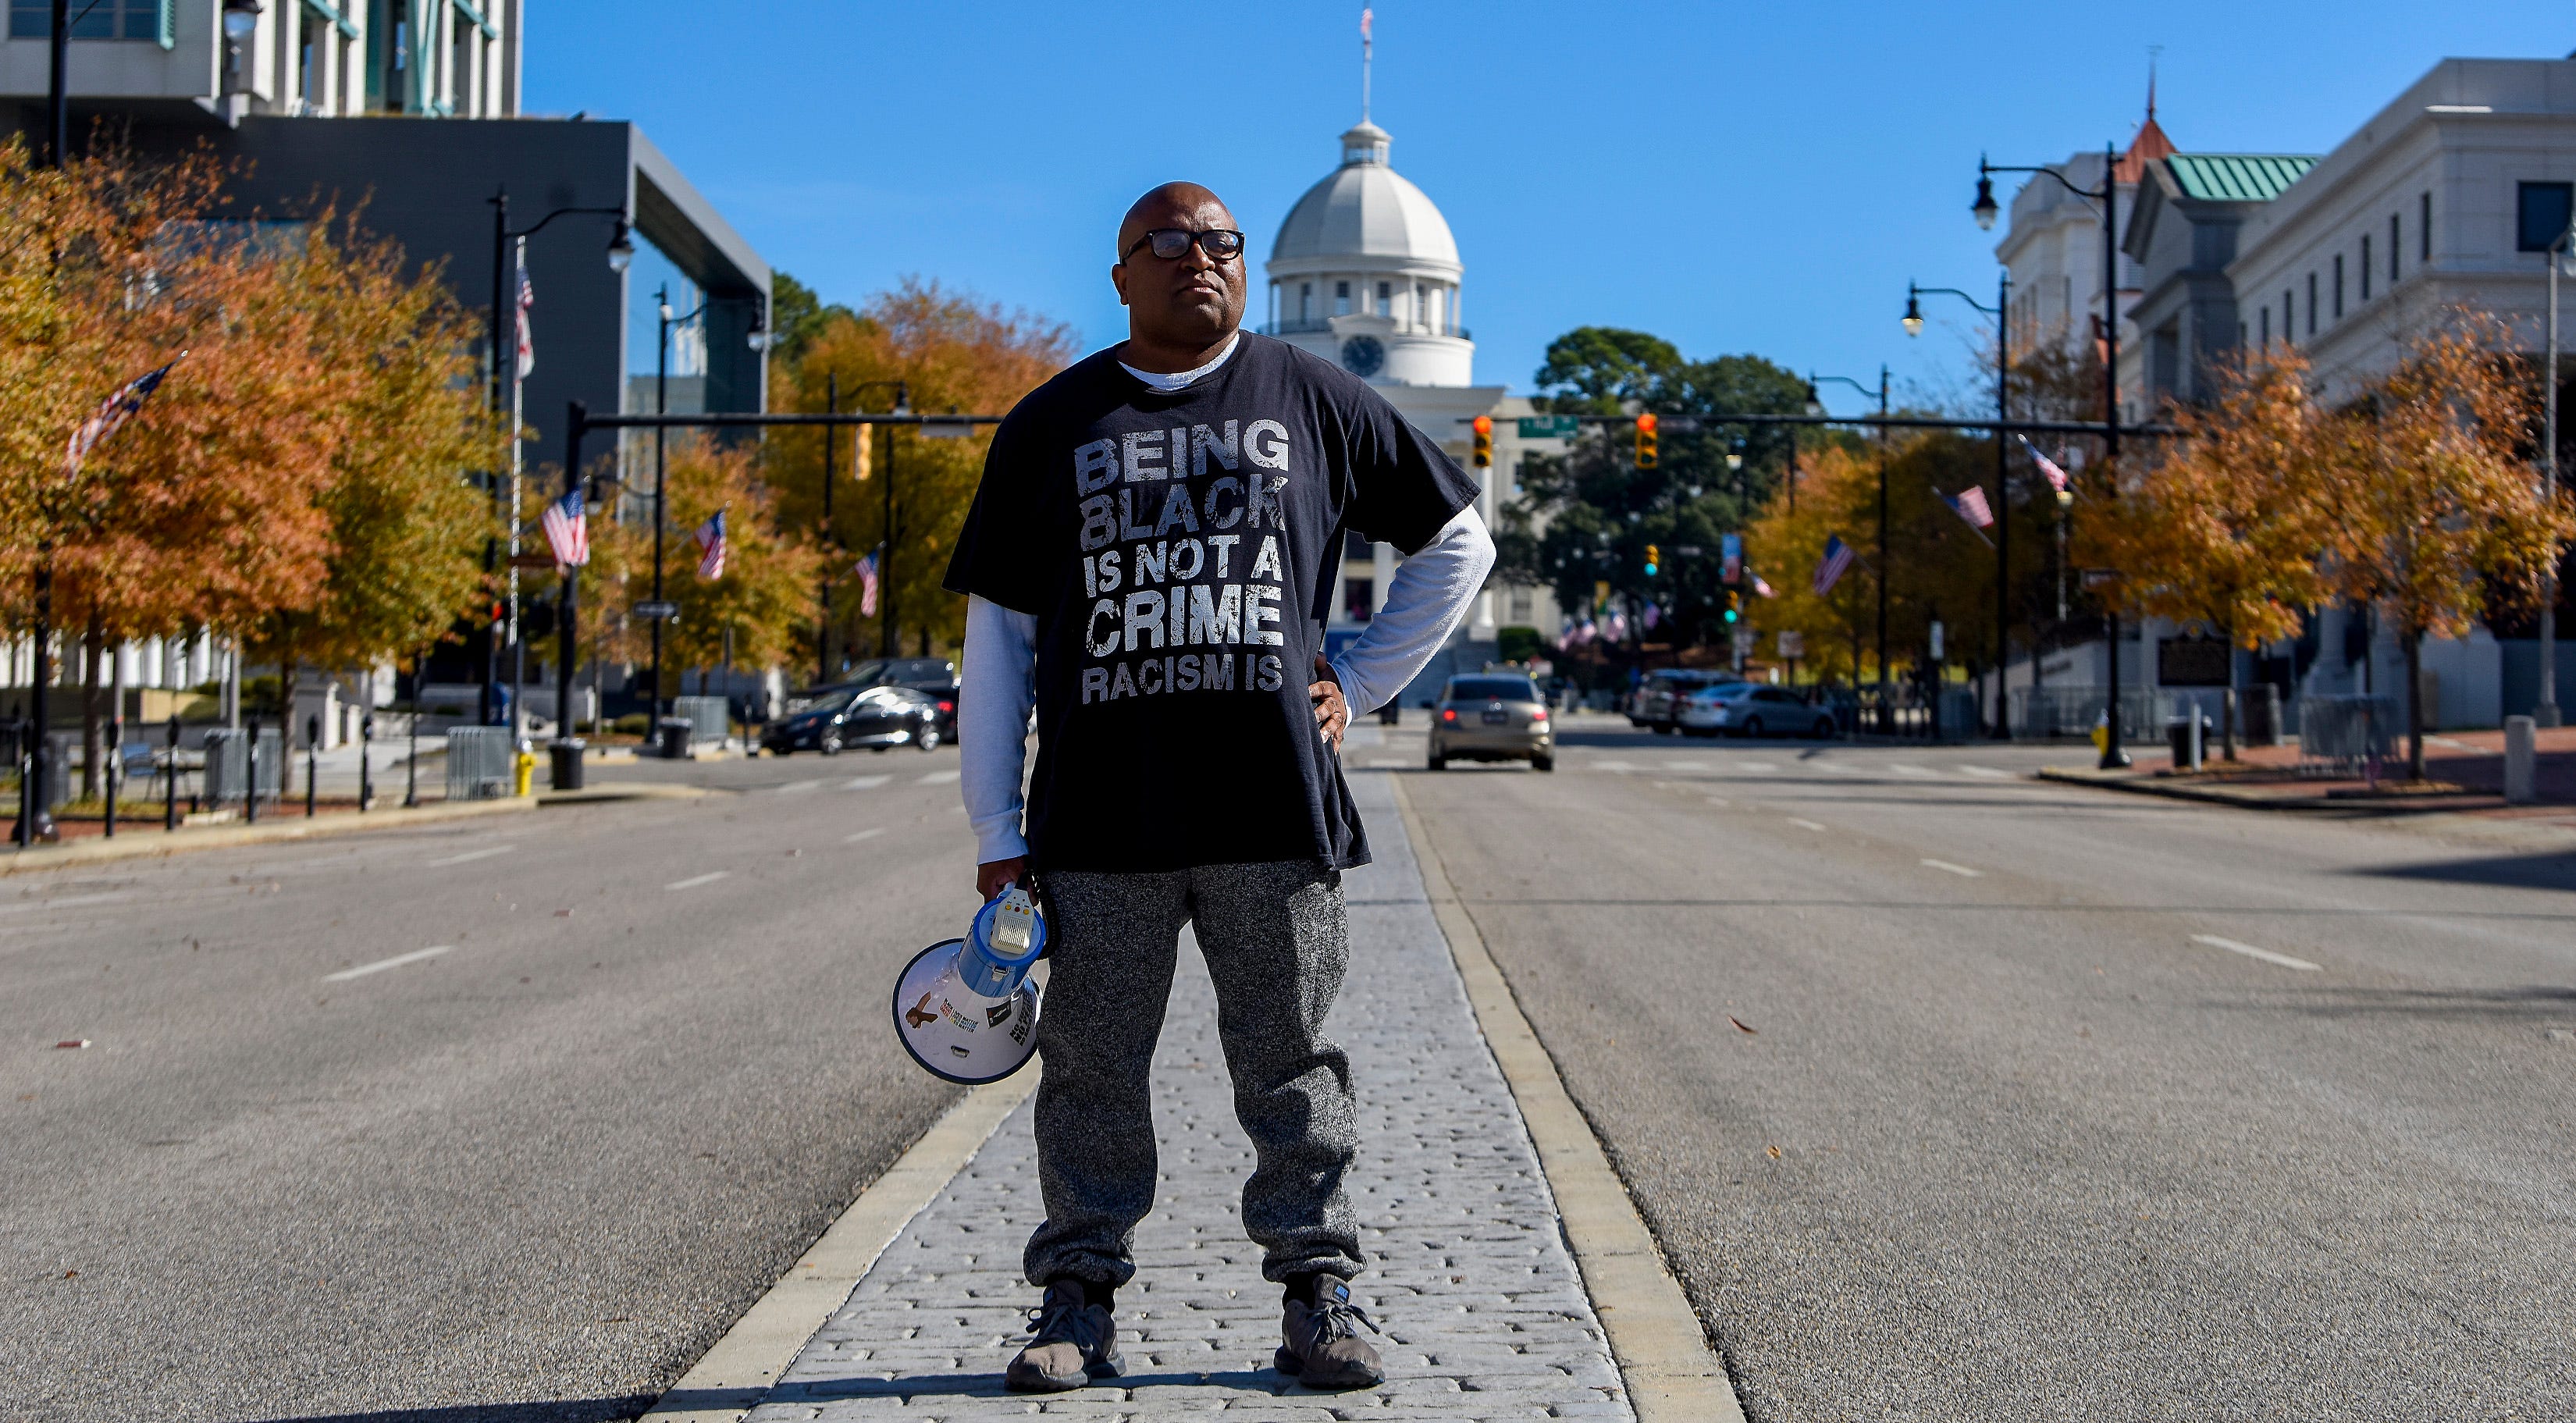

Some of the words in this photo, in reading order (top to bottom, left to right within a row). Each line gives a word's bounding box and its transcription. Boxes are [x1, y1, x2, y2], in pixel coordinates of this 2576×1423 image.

[1074, 418, 1290, 497] BEING
[1079, 473, 1289, 552] BLACK
[1083, 550, 1122, 598] IS
[1135, 535, 1240, 586] NOT
[1251, 535, 1283, 582] A
[1086, 584, 1284, 657] CRIME
[1082, 653, 1234, 704] RACISM
[1245, 653, 1283, 692] IS
